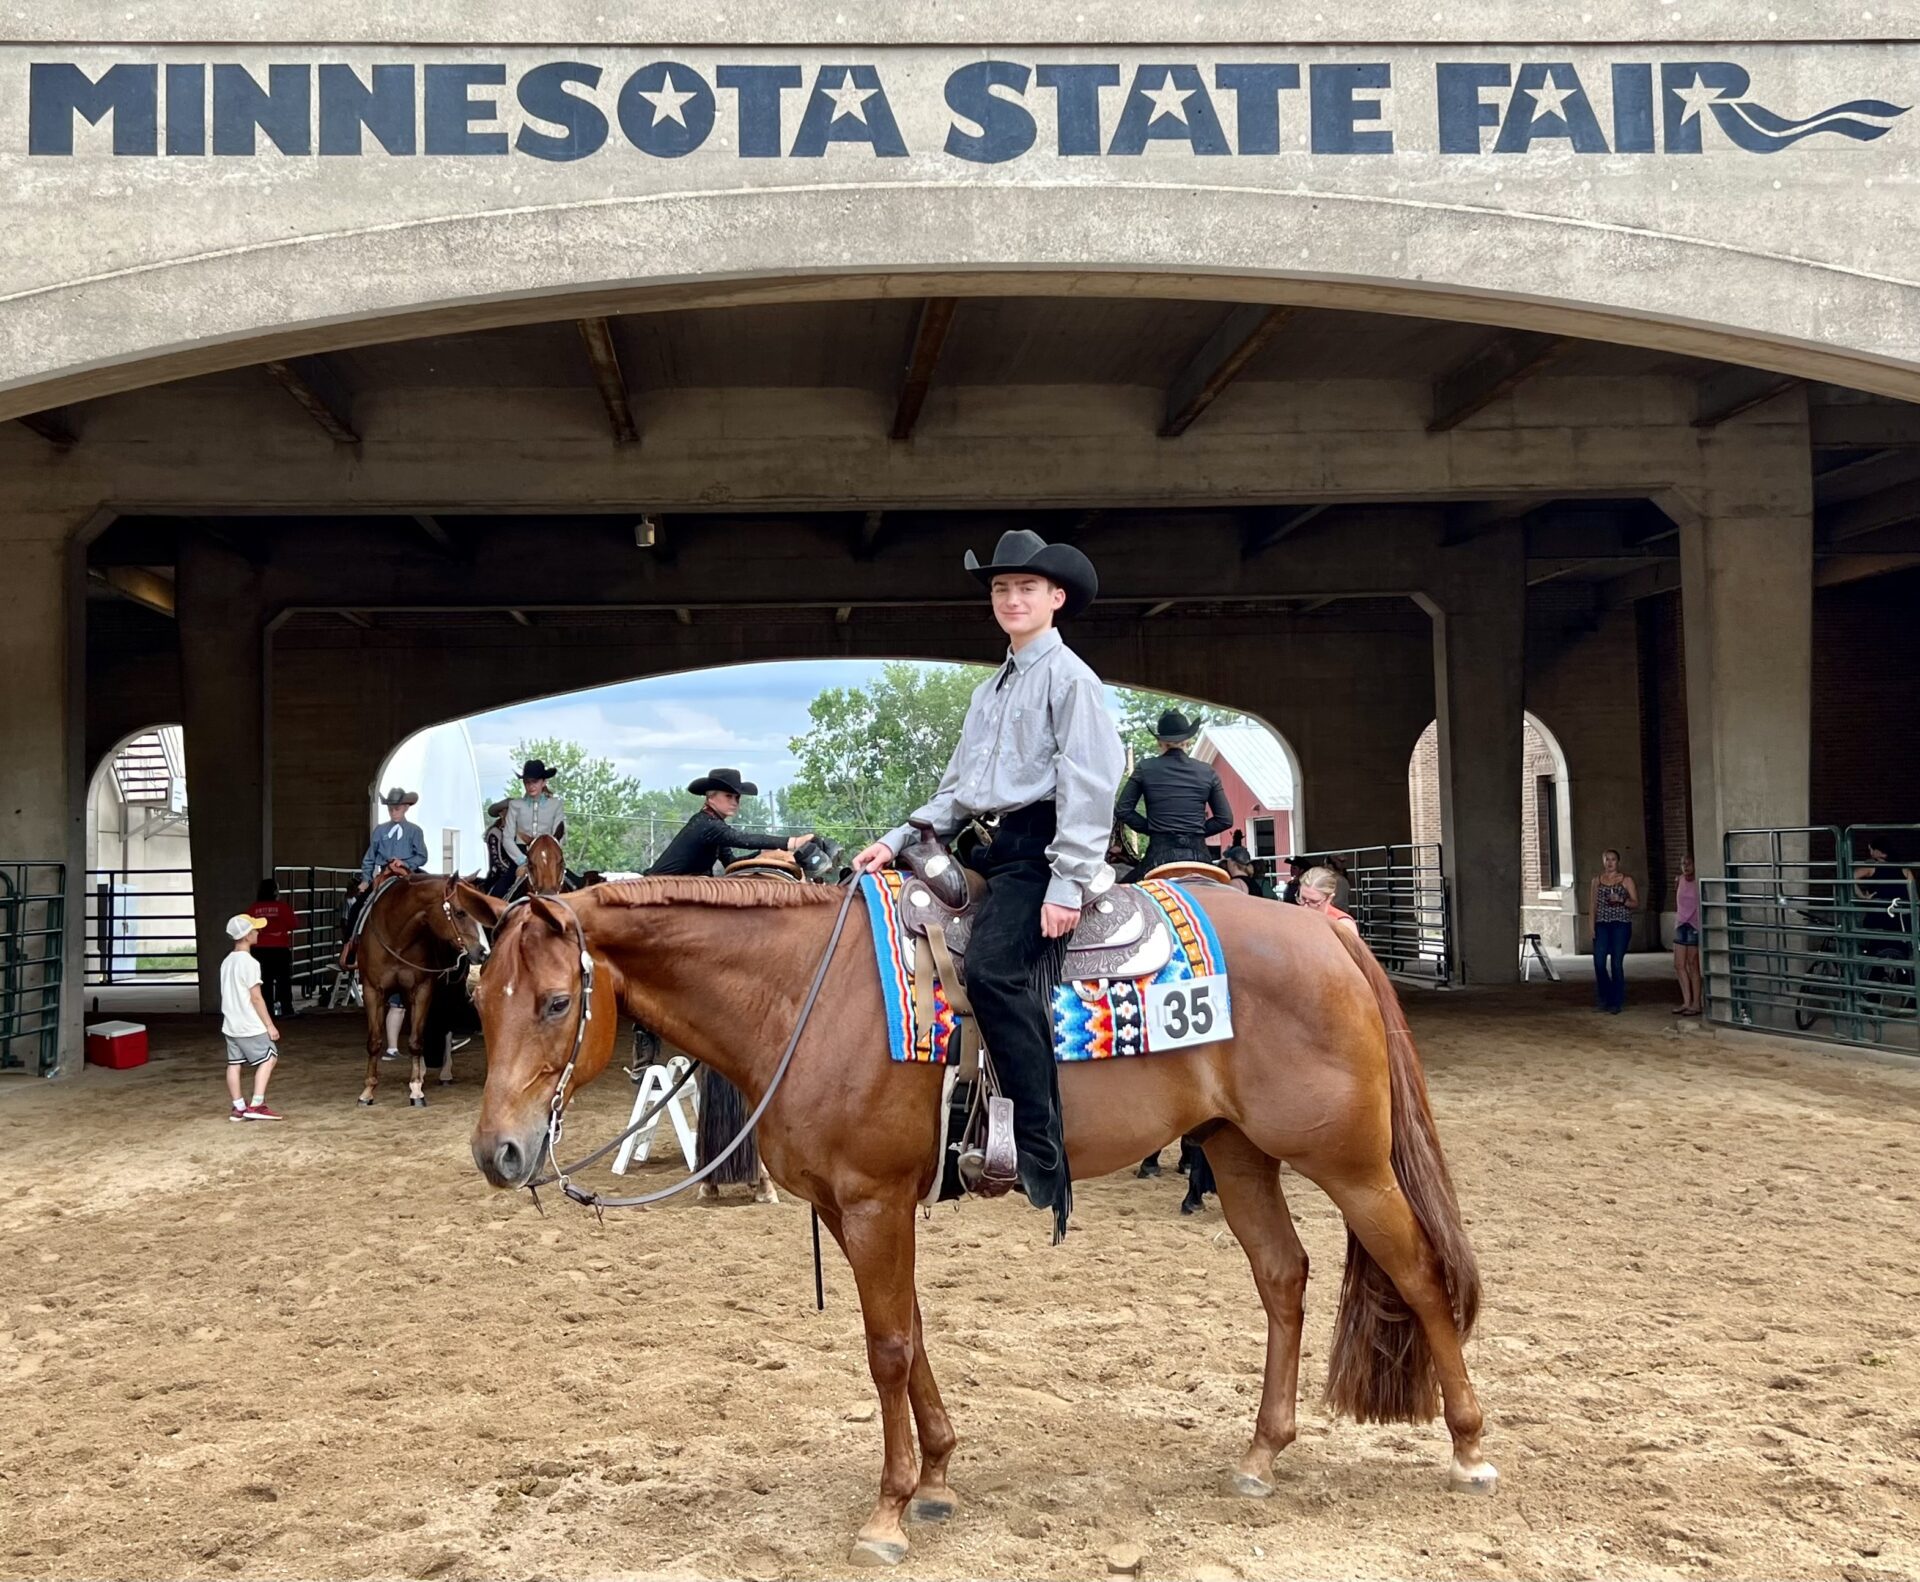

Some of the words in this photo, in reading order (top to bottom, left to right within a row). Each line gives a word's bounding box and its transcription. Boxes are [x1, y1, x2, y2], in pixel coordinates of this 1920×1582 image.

[29, 61, 910, 162] MINNESOTA
[943, 60, 1394, 164] STATE
[1436, 62, 1912, 154] FAIR
[1163, 986, 1213, 1039] 35
